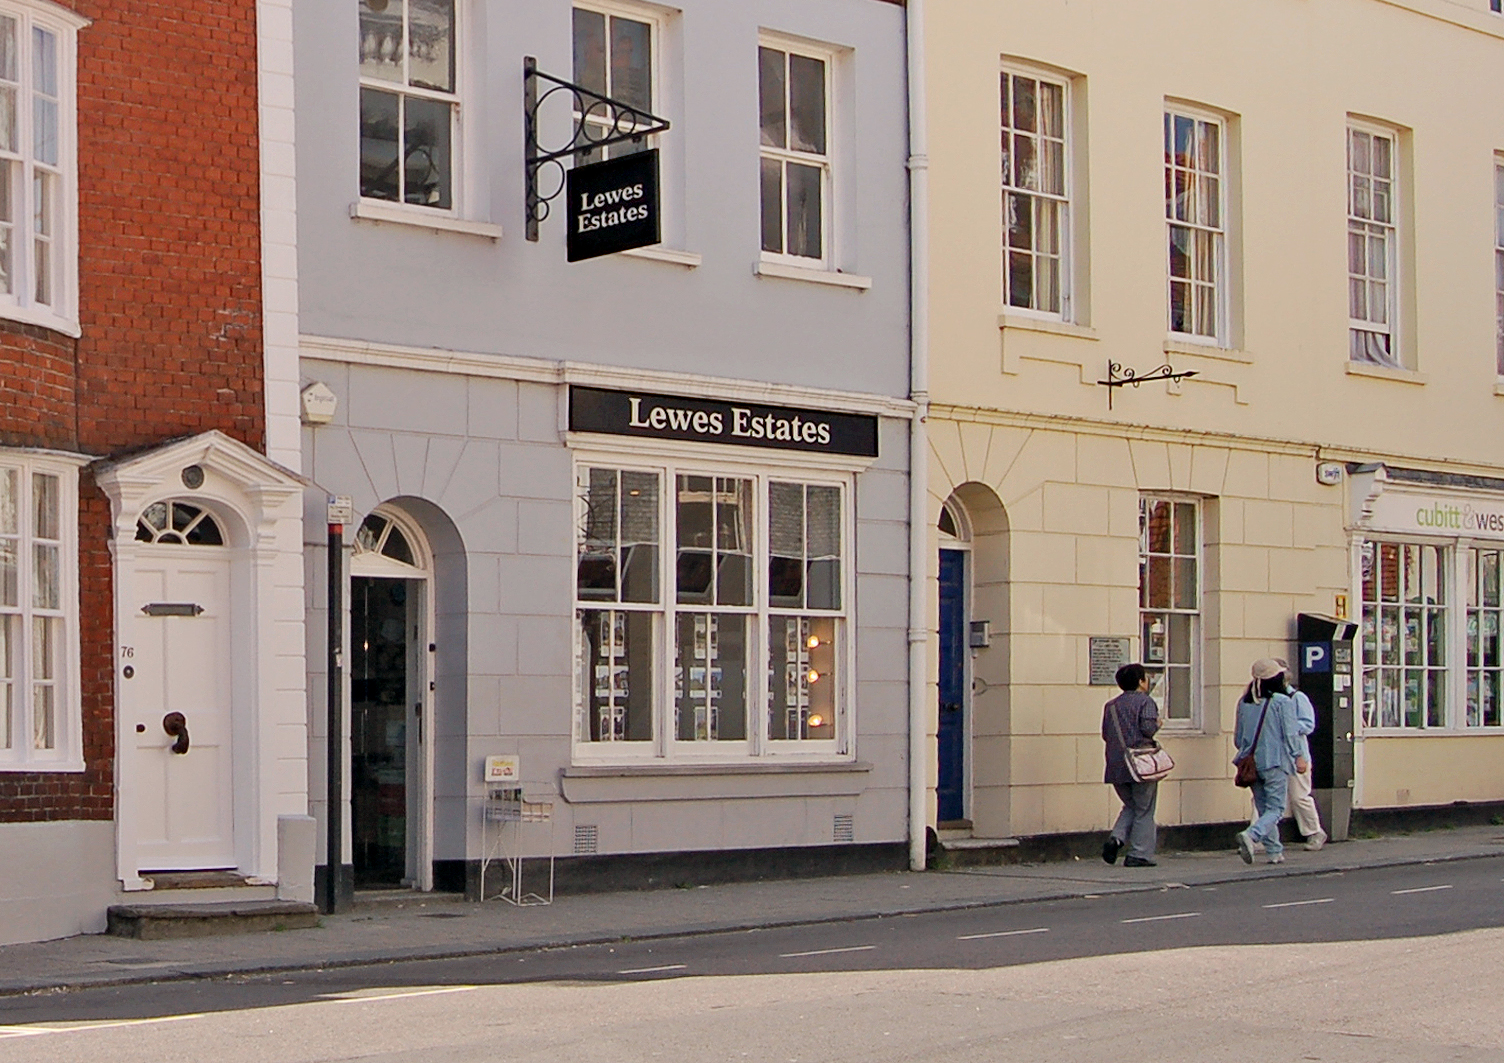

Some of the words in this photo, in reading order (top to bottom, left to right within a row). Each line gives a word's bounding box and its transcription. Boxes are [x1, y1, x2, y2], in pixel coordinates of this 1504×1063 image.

[581, 183, 644, 212] Lewes
[577, 204, 649, 234] Estates
[629, 397, 723, 435] Lewes
[731, 407, 831, 445] Estates
[1416, 501, 1461, 529] cubitt
[120, 646, 134, 658] 76
[1306, 645, 1325, 669] P
